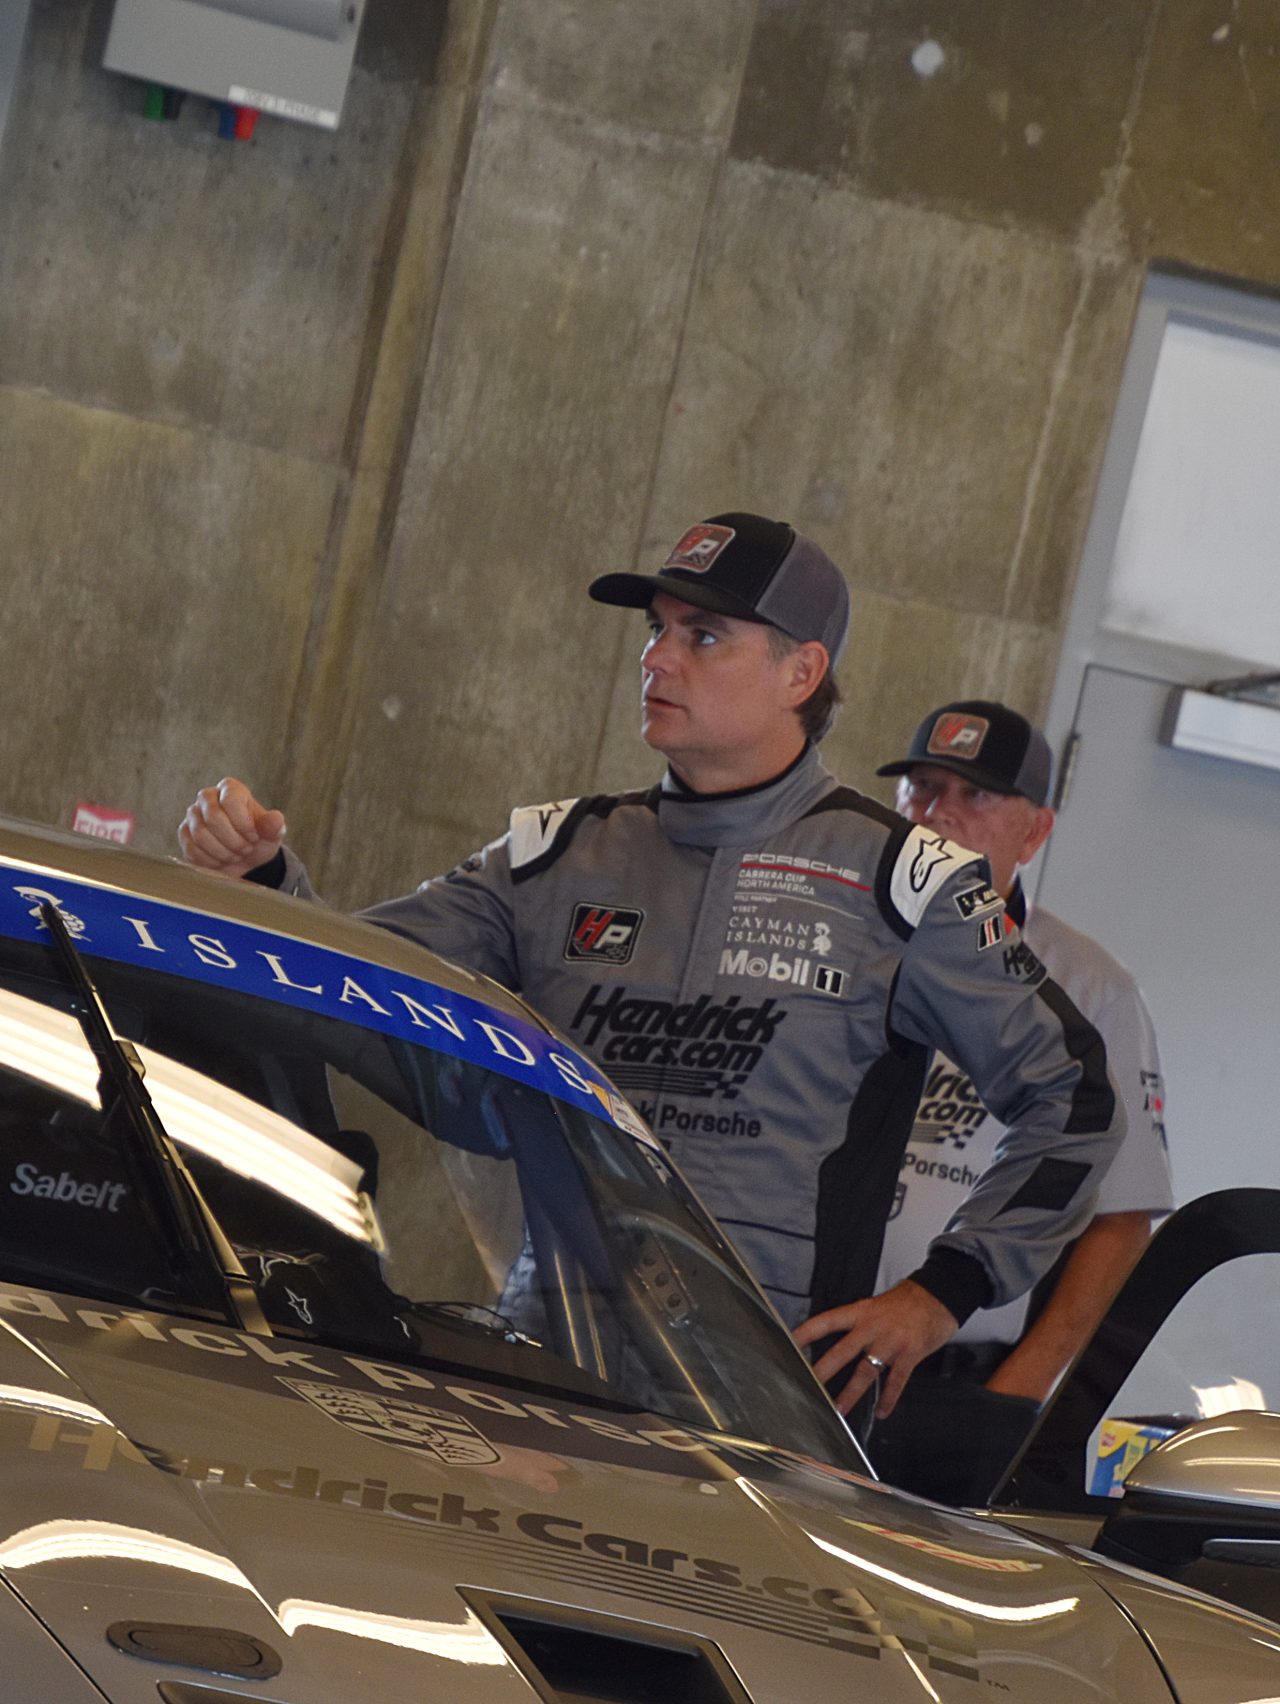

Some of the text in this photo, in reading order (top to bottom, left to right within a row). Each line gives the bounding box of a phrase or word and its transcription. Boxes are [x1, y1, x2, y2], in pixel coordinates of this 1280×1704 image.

[738, 869, 807, 883] CARRERA CUP
[742, 853, 861, 882] PORSCHE
[737, 879, 815, 896] NORTH AMERICA
[575, 908, 633, 952] HP
[725, 931, 807, 950] ISLANDS
[728, 916, 811, 936] CAYMAN
[718, 949, 811, 987] Mobil
[122, 916, 592, 1095] ISLANDS
[570, 984, 788, 1046] Hendrick
[602, 1035, 765, 1073] cars.com
[659, 1104, 762, 1138] Porsche
[901, 1152, 981, 1187] Porsch
[9, 1162, 127, 1213] Sabelt
